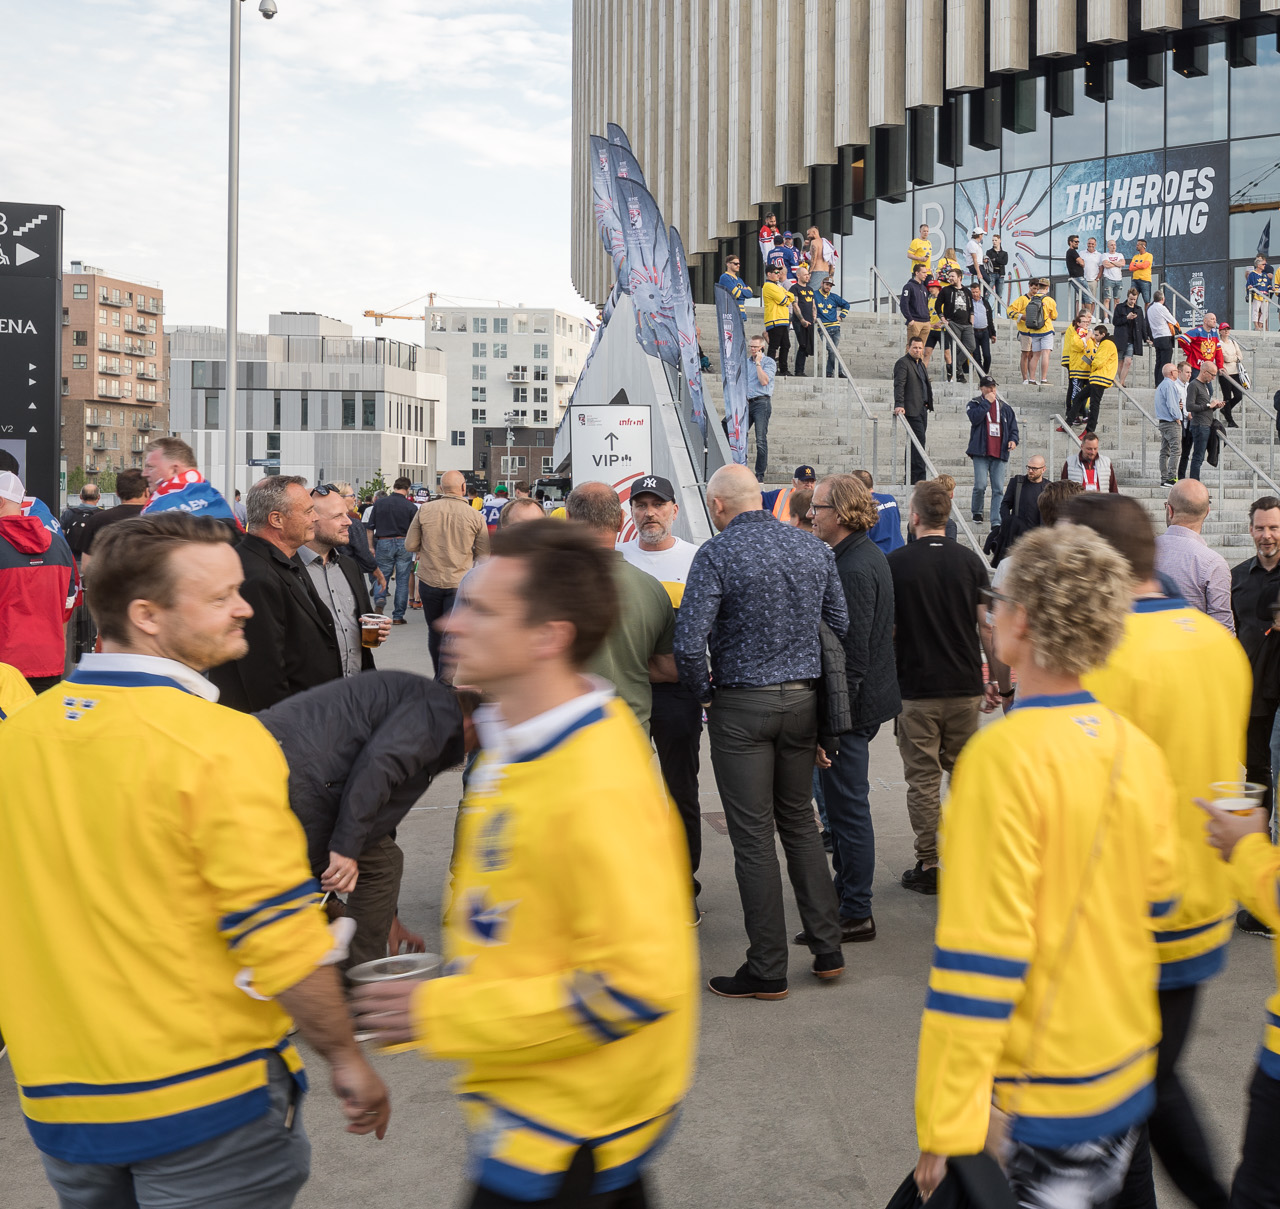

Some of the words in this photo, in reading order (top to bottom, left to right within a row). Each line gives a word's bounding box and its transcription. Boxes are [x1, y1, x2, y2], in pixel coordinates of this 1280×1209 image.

[1066, 180, 1109, 215] THE
[1110, 167, 1215, 210] HEROES
[921, 202, 946, 261] B
[1077, 213, 1103, 232] ARE
[1105, 202, 1209, 241] COMING
[0, 425, 14, 433] V2
[592, 454, 619, 467] VIP
